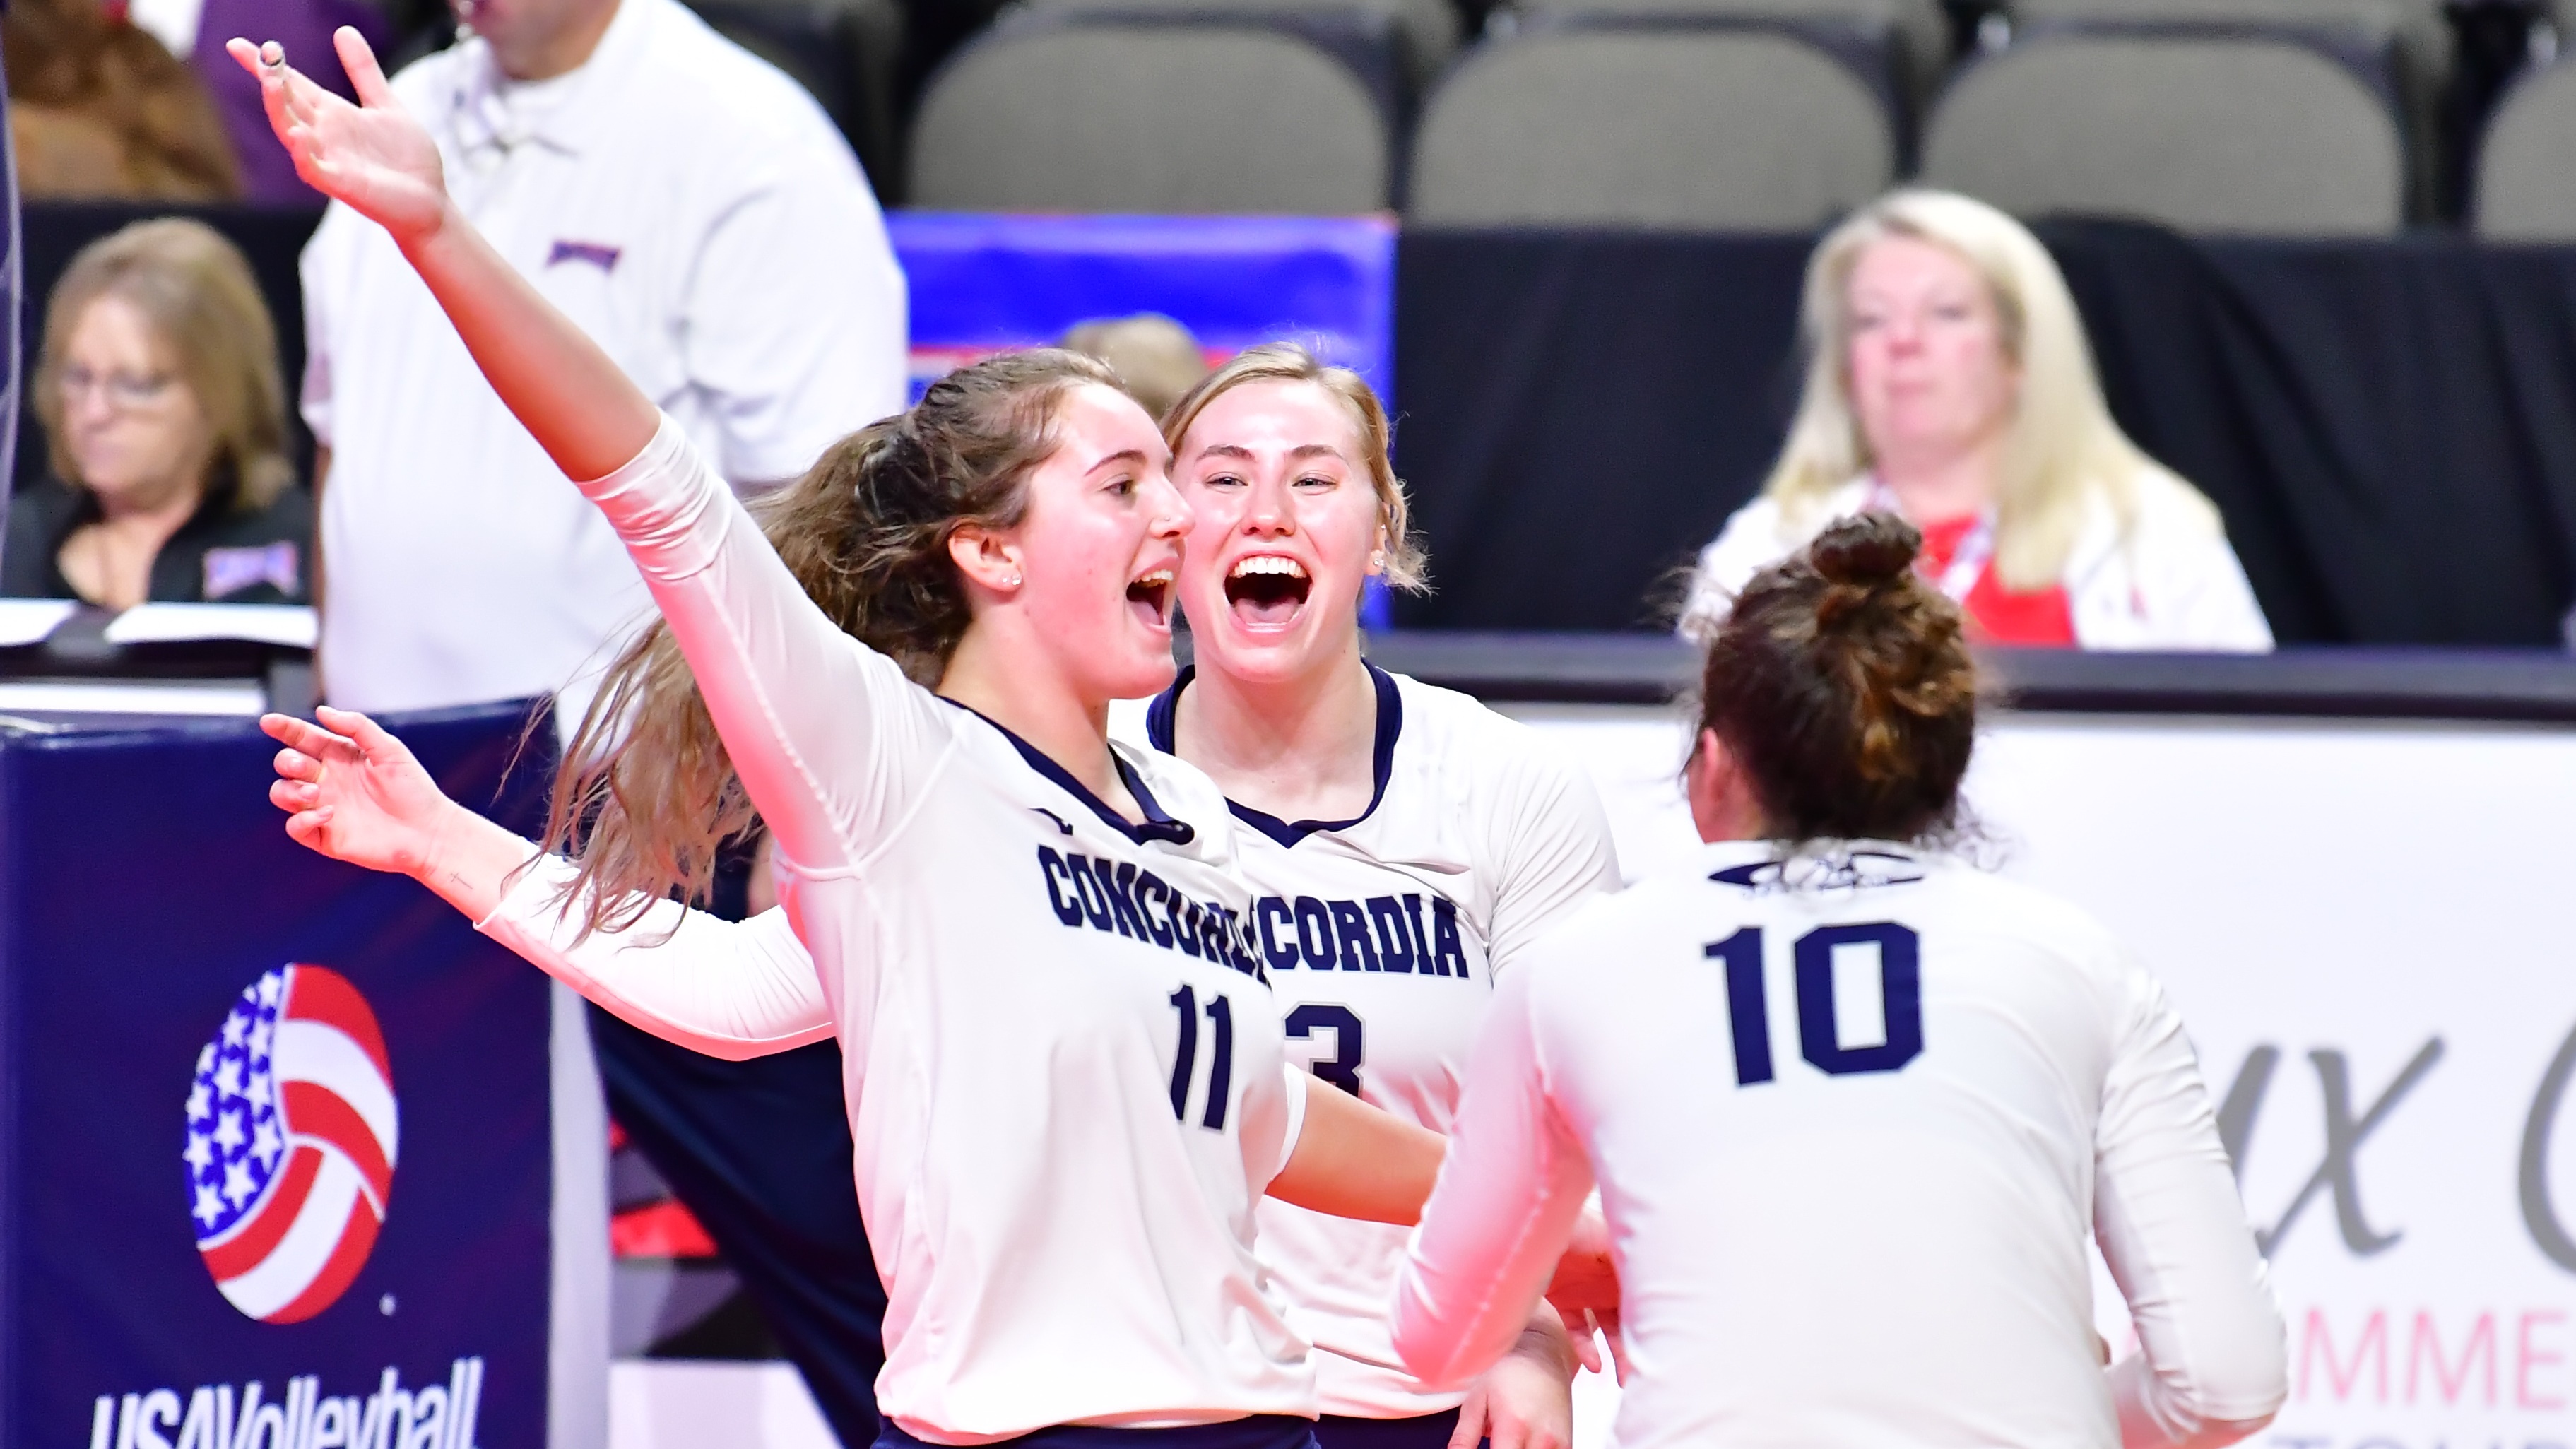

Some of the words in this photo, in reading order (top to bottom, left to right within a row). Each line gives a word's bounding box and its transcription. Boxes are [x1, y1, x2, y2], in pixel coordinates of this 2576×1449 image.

[1243, 894, 1470, 979] CORDIA
[1167, 979, 1235, 1135] 11
[1282, 1001, 1366, 1099] 3
[1703, 920, 1926, 1089] 10
